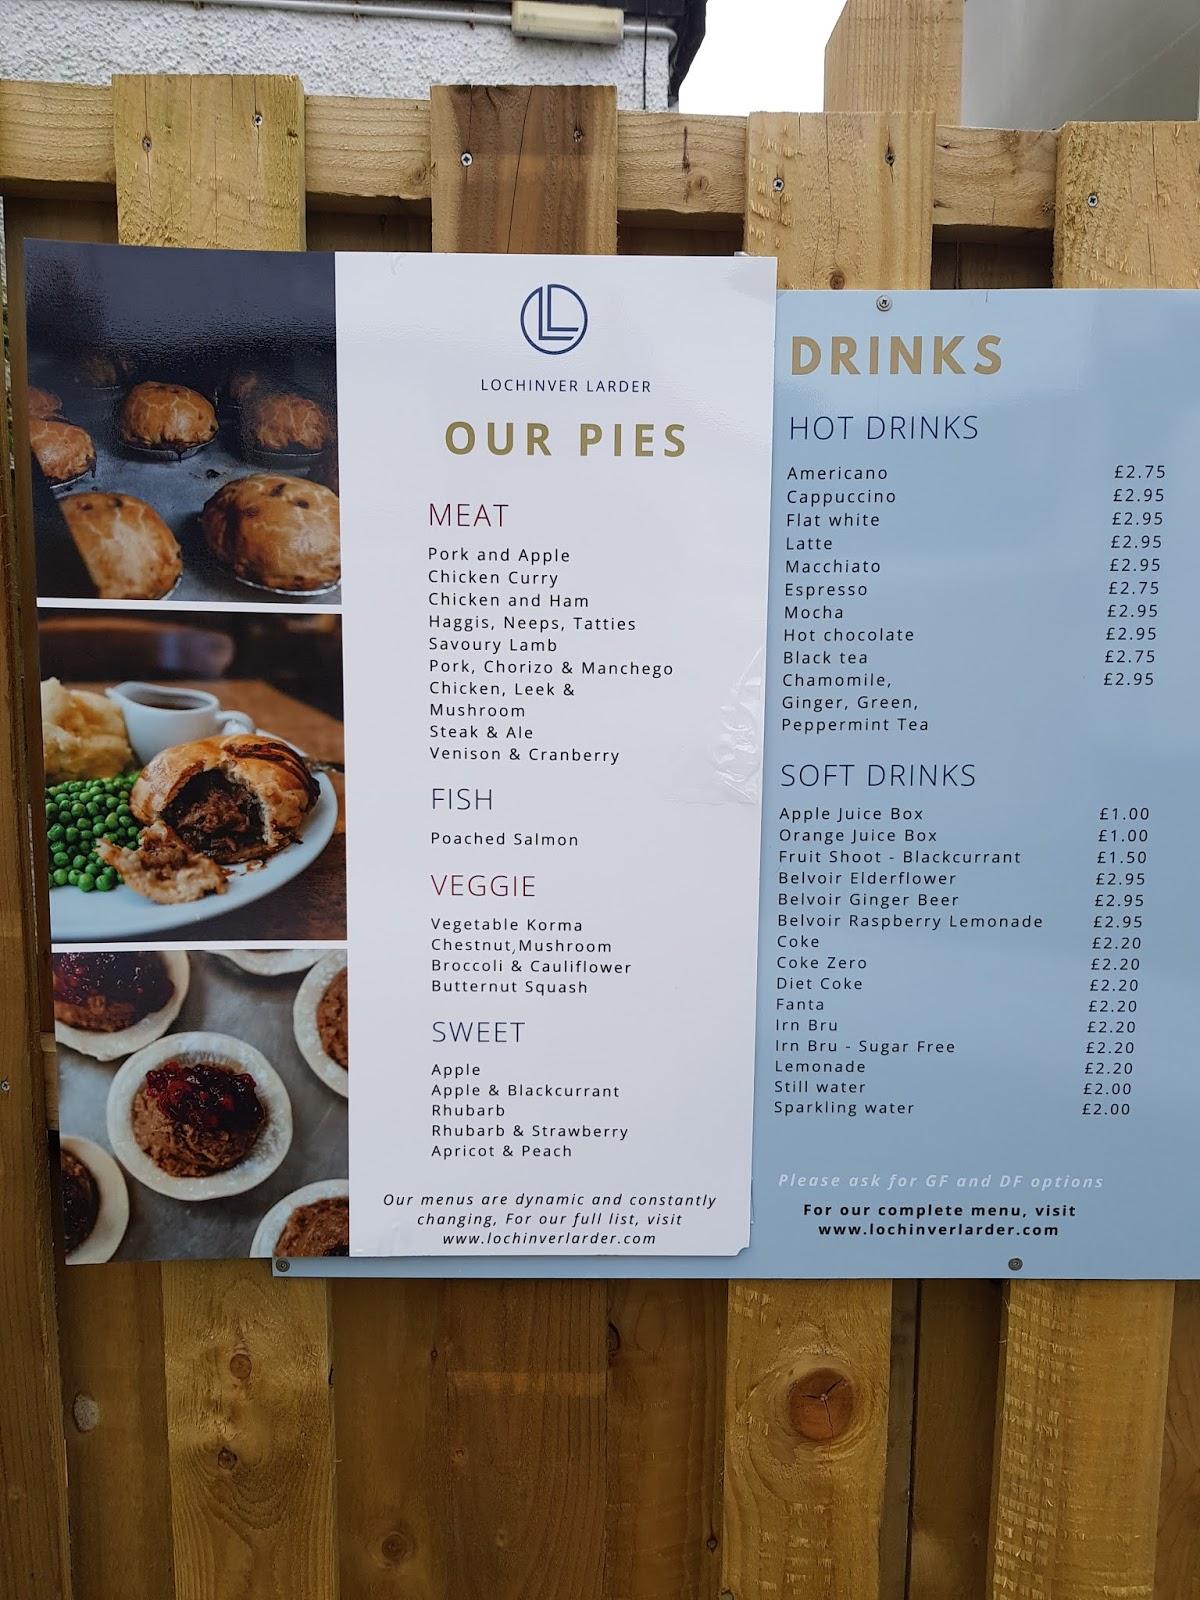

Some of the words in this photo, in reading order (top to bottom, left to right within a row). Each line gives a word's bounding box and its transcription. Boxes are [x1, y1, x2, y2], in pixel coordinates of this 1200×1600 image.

[791, 334, 1002, 376] DRINKS
[481, 378, 579, 393] LOCHINVER
[586, 379, 651, 393] LARDER
[790, 415, 855, 441] HOT
[867, 415, 978, 440] DRINKS
[445, 421, 552, 457] OUR
[579, 423, 686, 458] PIES
[786, 466, 888, 481] Americano
[1114, 464, 1166, 479] £2.75
[786, 489, 896, 508] Cappuccino
[1112, 488, 1165, 503] £2.95
[429, 502, 510, 528] MEAT
[786, 512, 821, 528] Flat
[828, 512, 880, 527] white
[1111, 511, 1163, 526] £2.95
[786, 536, 833, 551] Latte
[1110, 534, 1162, 549] £2.95
[428, 546, 469, 561] Pork
[476, 547, 510, 562] and
[517, 547, 570, 567] Apple
[1109, 557, 1161, 572] £2.95
[785, 558, 881, 574] Macchiato
[428, 568, 500, 585] Chicken
[508, 570, 559, 589] Curry
[785, 582, 868, 601] Espresso
[1108, 581, 1159, 595] £2.75
[428, 591, 500, 607] Chicken
[507, 592, 541, 608] and
[549, 593, 589, 608] Ham
[784, 604, 843, 620] Mocha
[1106, 603, 1158, 618] £2.95
[429, 614, 495, 633] Haggis,
[503, 615, 565, 634] Neeps,
[572, 616, 636, 631] Tatties
[784, 628, 816, 643] Hot
[823, 627, 914, 642] chocolate
[1105, 626, 1157, 641] £2.95
[428, 636, 502, 655] Savoury
[509, 637, 557, 652] Lamb
[783, 650, 832, 665] Black
[839, 652, 868, 665] tea
[1104, 649, 1155, 664] £2.75
[429, 658, 475, 675] Pork,
[483, 659, 553, 675] Chorizo
[581, 660, 673, 679] Manchego
[782, 672, 891, 689] Chamomile,
[1103, 672, 1154, 686] £2.95
[429, 680, 506, 698] Chicken,
[514, 681, 555, 697] Leek
[429, 703, 525, 718] Mushroom
[781, 695, 849, 713] Ginger,
[857, 695, 918, 711] Green,
[429, 724, 479, 739] Steak
[505, 725, 533, 740] Ale
[781, 717, 889, 735] Peppermint
[896, 717, 929, 732] Tea
[429, 746, 501, 761] Venison
[528, 747, 620, 766] Cranberry
[780, 763, 856, 787] SOFT
[867, 763, 976, 787] DRINKS
[432, 787, 493, 811] FISH
[778, 806, 831, 824] Apple
[836, 807, 882, 823] Juice
[890, 807, 923, 821] Box
[1099, 807, 1150, 821] £1.00
[431, 831, 505, 846] Poached
[513, 832, 578, 847] Salmon
[779, 828, 845, 846] Orange
[850, 828, 896, 845] Juice
[904, 828, 937, 842] Box
[1097, 828, 1148, 843] £1.00
[779, 850, 822, 864] Fruit
[828, 849, 881, 864] Shoot
[903, 849, 1021, 864] Blackcurrant
[1096, 850, 1147, 865] £1.50
[429, 874, 536, 897] VEGGIE
[778, 871, 843, 885] Belvoir
[850, 871, 957, 886] Elderflower
[1095, 872, 1145, 886] £2.95
[778, 892, 842, 906] Belvoir
[849, 892, 910, 910] Ginger
[918, 893, 959, 907] Beer
[1094, 893, 1144, 908] £2.95
[430, 917, 519, 934] Vegetable
[527, 918, 583, 932] Korma
[777, 913, 841, 927] Belvoir
[849, 913, 942, 932] Raspberry
[949, 914, 1043, 929] Lemonade
[1093, 915, 1143, 929] £2.95
[777, 934, 820, 949] Coke
[1091, 936, 1142, 950] £2.20
[431, 958, 503, 973] Broccoli
[530, 959, 632, 975] Cauliflower
[776, 955, 819, 969] Coke
[826, 956, 867, 970] Zero
[1090, 957, 1140, 971] £2.20
[431, 979, 518, 993] Butternut
[525, 980, 588, 997] Squash
[776, 976, 813, 990] Diet
[820, 976, 863, 991] Coke
[1089, 978, 1139, 992] £2.20
[776, 997, 824, 1011] Fanta
[1088, 999, 1137, 1013] £2.20
[432, 1021, 526, 1043] SWEET
[775, 1018, 800, 1032] Irn
[808, 1018, 838, 1032] Bru
[1086, 1020, 1136, 1034] £2.20
[775, 1039, 799, 1052] Irn
[807, 1039, 837, 1053] Bru
[858, 1039, 910, 1057] Sugar
[917, 1040, 955, 1054] Free
[1085, 1041, 1135, 1055] £2.20
[430, 1063, 481, 1080] Apple
[775, 1059, 866, 1073] Lemonade
[1084, 1062, 1133, 1075] £2.20
[431, 1083, 481, 1100] Apple
[507, 1083, 620, 1098] Blackcurrant
[774, 1079, 808, 1093] Still
[815, 1081, 866, 1094] water
[1082, 1082, 1132, 1096] £2.00
[431, 1103, 505, 1117] Rhubarb
[773, 1100, 857, 1118] Sparkling
[864, 1102, 915, 1115] water
[1081, 1103, 1130, 1116] £2.00
[431, 1123, 505, 1137] Rhubarb
[531, 1124, 629, 1142] Strawberry
[430, 1144, 495, 1161] Apricot
[521, 1144, 572, 1158] Peach
[778, 1173, 840, 1187] Please
[956, 1174, 992, 1188] and
[1030, 1176, 1104, 1192] options
[383, 1193, 414, 1206] Our
[420, 1195, 475, 1206] menus
[481, 1195, 508, 1206] are
[515, 1192, 585, 1209] dynamic
[591, 1192, 623, 1206] and
[629, 1193, 718, 1210] constantly
[803, 1203, 833, 1216] For
[839, 1206, 871, 1216] our
[877, 1203, 964, 1220] complete
[971, 1206, 1027, 1219] menu,
[1034, 1204, 1076, 1217] visit
[417, 1212, 497, 1229] changing,
[505, 1212, 532, 1225] For
[538, 1215, 568, 1225] our
[571, 1211, 602, 1229] full
[608, 1212, 639, 1228] list,
[647, 1212, 683, 1226] visit
[817, 1222, 1059, 1236] www.lochinverlarder.com
[442, 1231, 656, 1245] www.lochinverlarder.com
